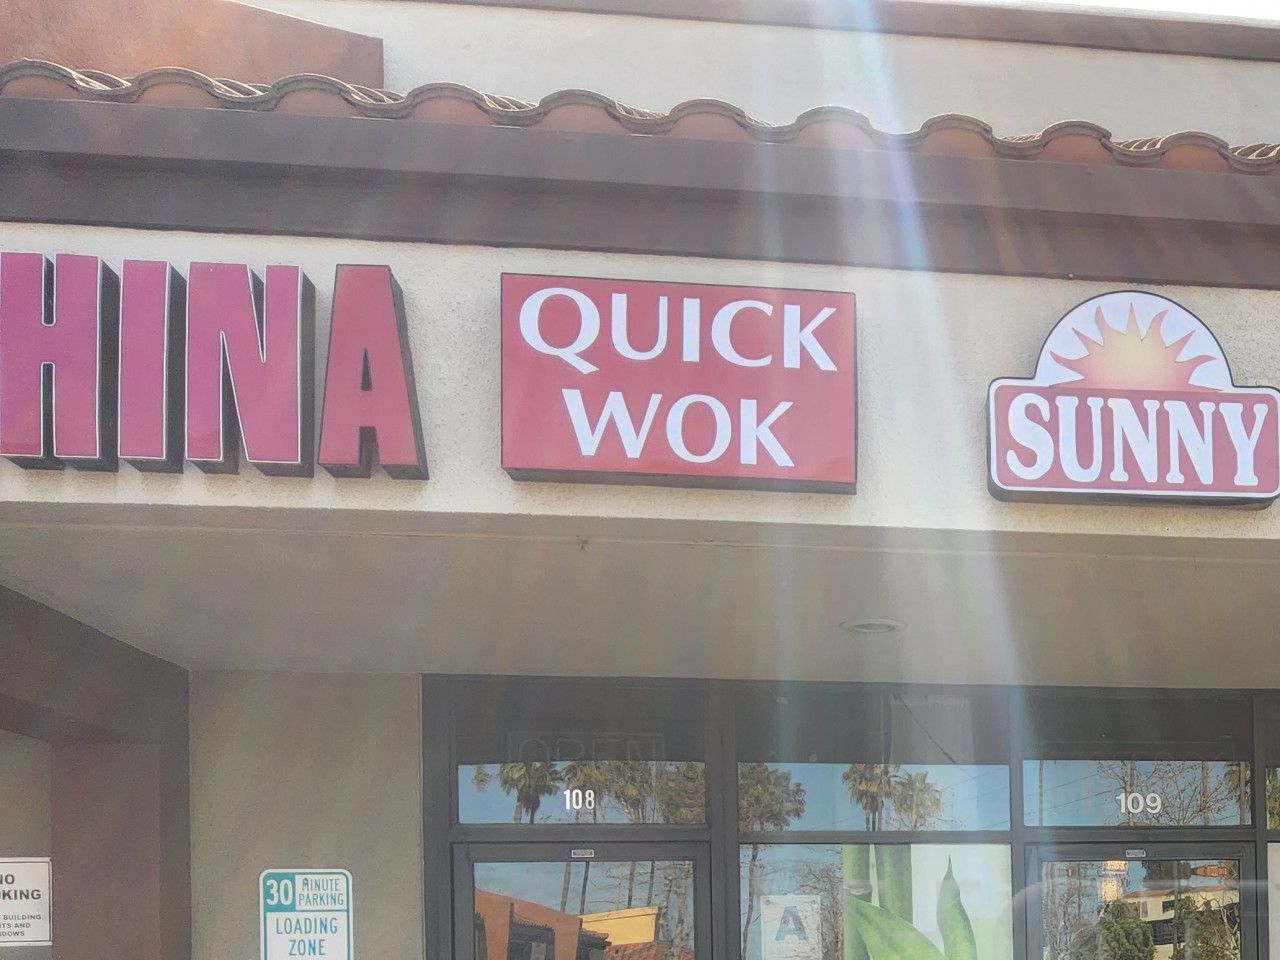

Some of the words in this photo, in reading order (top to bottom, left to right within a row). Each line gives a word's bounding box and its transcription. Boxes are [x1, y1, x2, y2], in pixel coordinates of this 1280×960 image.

[519, 287, 838, 374] QUICK
[561, 387, 795, 468] WOK
[1006, 392, 1269, 486] SUNNY
[564, 789, 596, 810] 108
[1116, 792, 1162, 813] 109
[0, 889, 42, 900] KING
[266, 879, 293, 906] 30
[302, 878, 340, 891] MINUTE
[298, 893, 344, 906] PARKING
[276, 917, 338, 935] LOADING
[774, 905, 808, 941] A
[288, 939, 326, 956] ZONE
